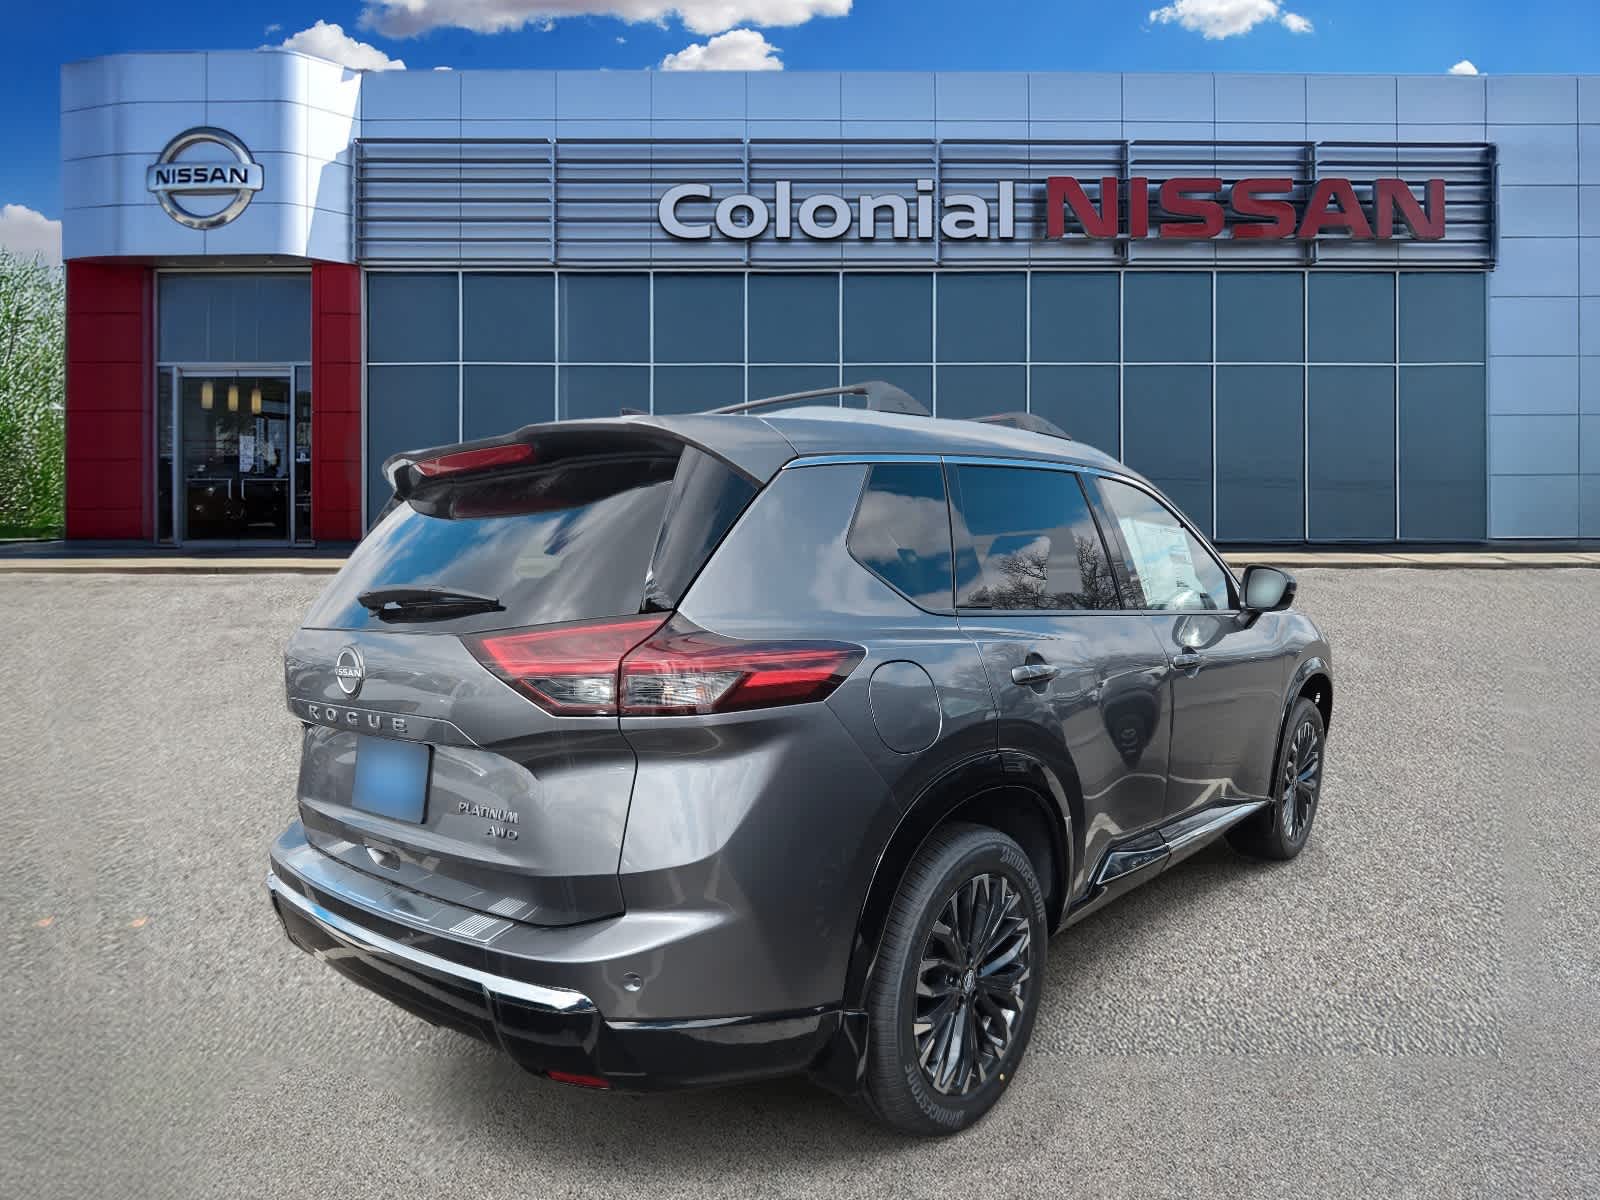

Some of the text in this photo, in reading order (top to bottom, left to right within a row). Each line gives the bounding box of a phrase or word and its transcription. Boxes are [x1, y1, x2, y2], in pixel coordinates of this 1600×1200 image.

[155, 167, 248, 185] NISSAN
[658, 176, 1446, 241] Colonial NISSAN
[308, 704, 408, 733] ROGUE
[458, 801, 519, 824] PLATINUM
[487, 825, 518, 840] AWD
